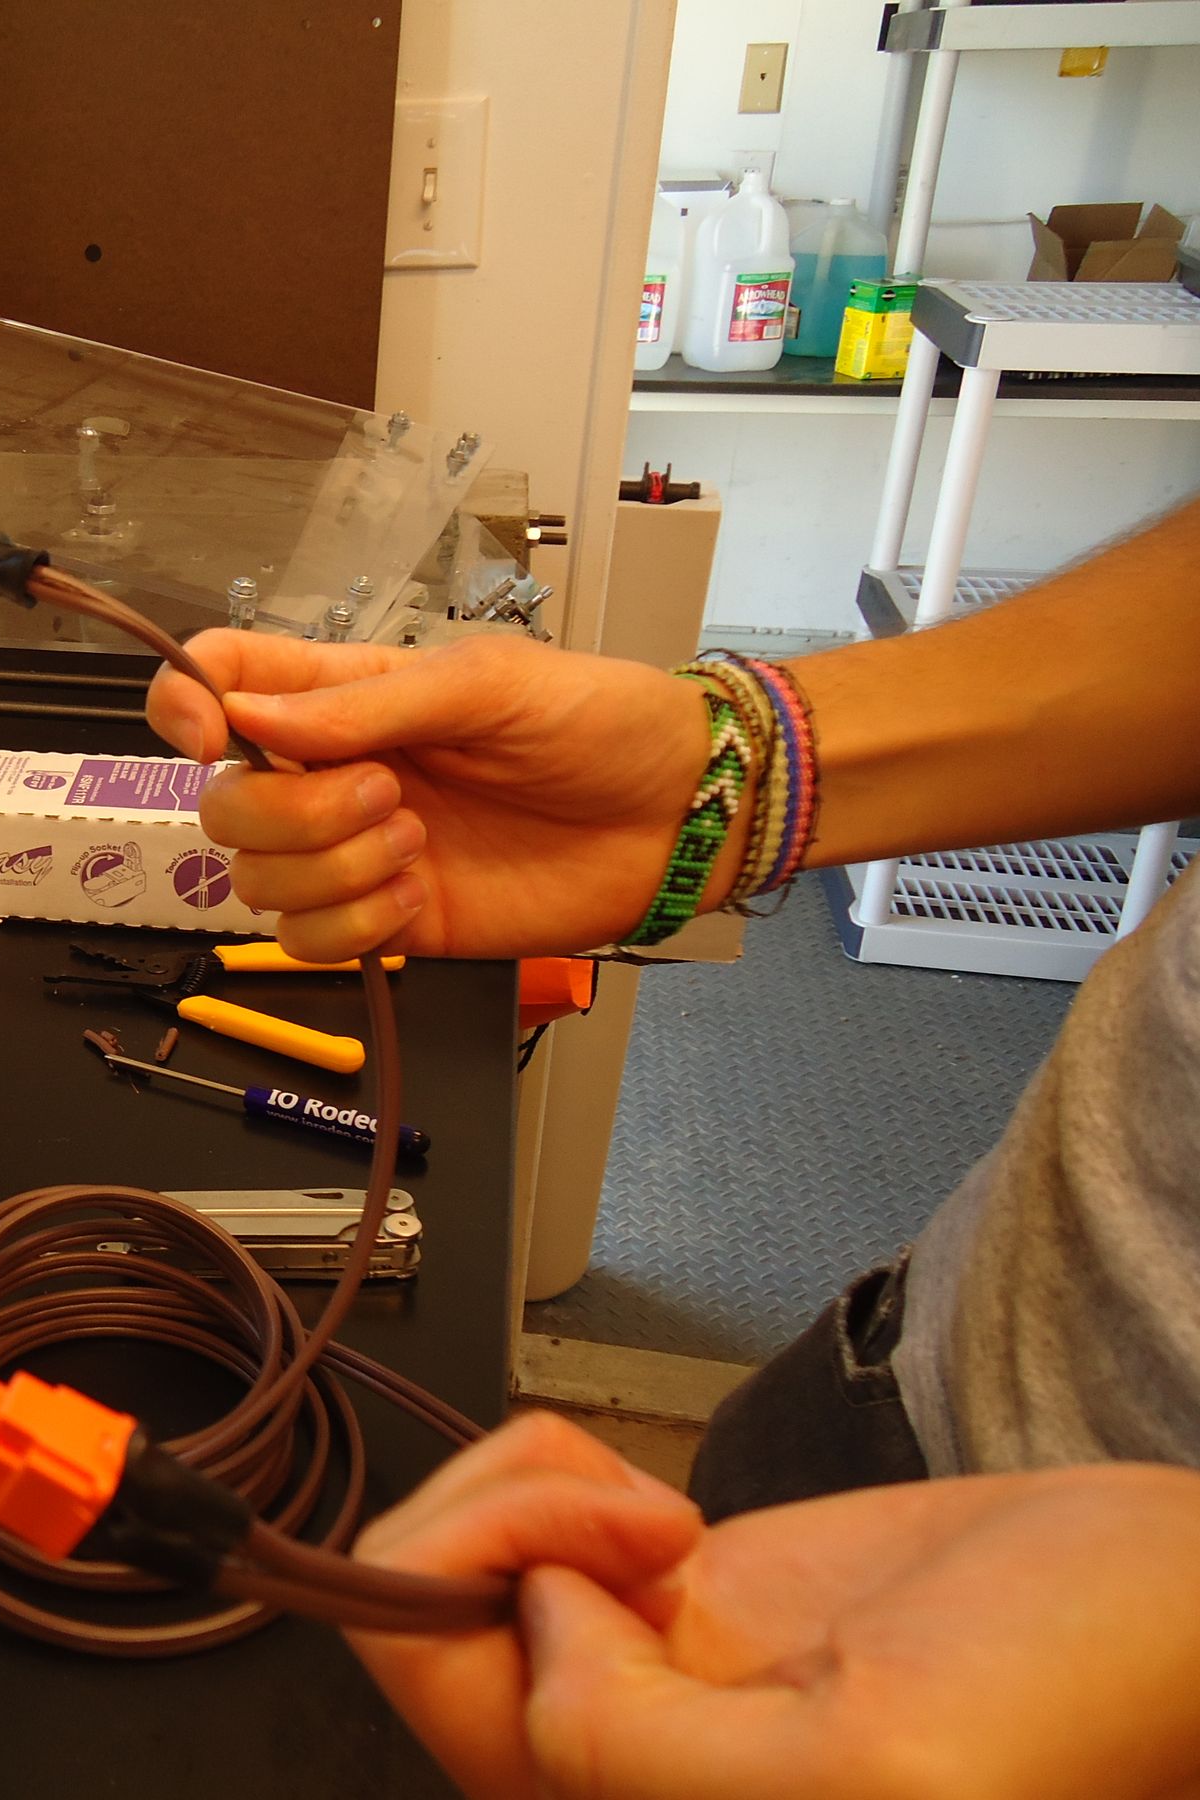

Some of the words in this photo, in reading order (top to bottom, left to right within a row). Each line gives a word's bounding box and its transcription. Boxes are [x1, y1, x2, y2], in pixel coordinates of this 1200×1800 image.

[71, 850, 90, 876] Flip-up
[89, 843, 122, 854] Socket
[165, 848, 198, 875] Tool-less
[208, 848, 232, 866] Entry
[267, 1089, 299, 1109] IO
